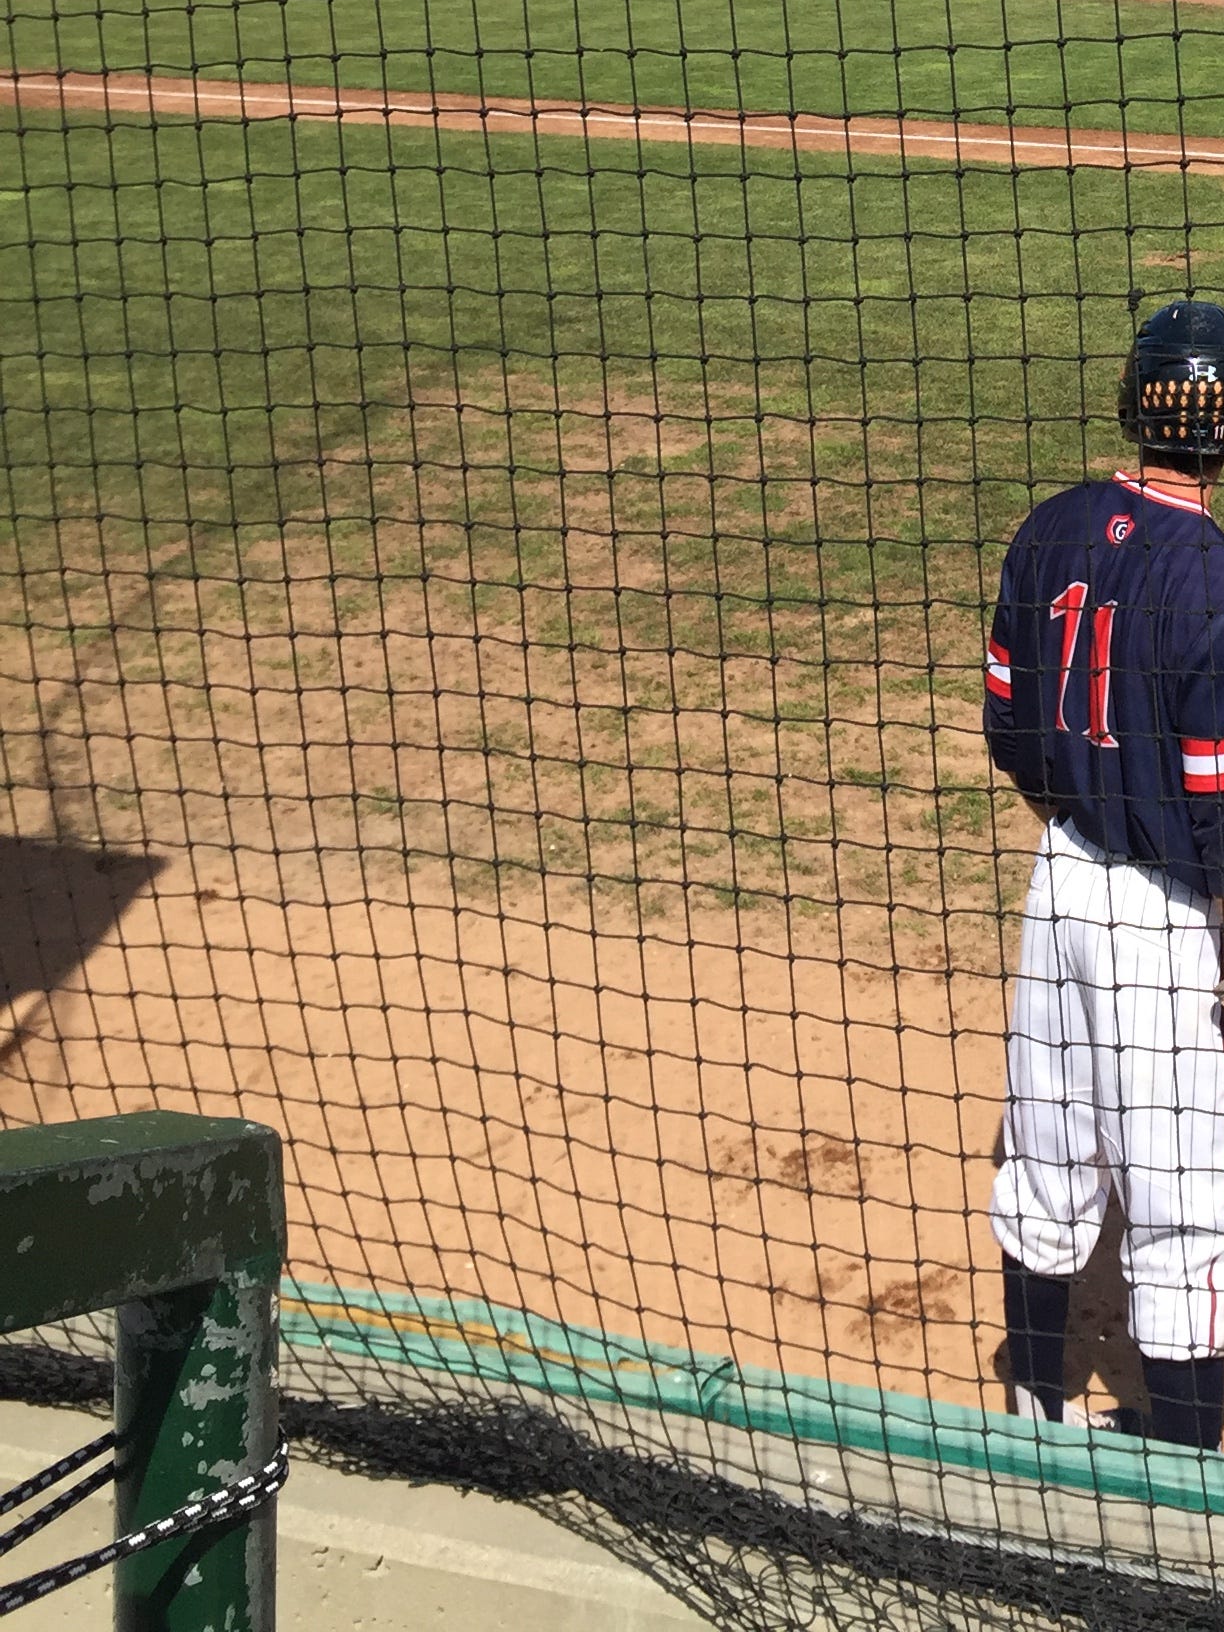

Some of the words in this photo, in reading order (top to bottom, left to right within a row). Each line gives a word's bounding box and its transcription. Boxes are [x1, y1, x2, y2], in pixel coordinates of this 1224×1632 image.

[1213, 424, 1224, 440] 11
[1115, 523, 1128, 542] G
[1050, 581, 1119, 748] 11
